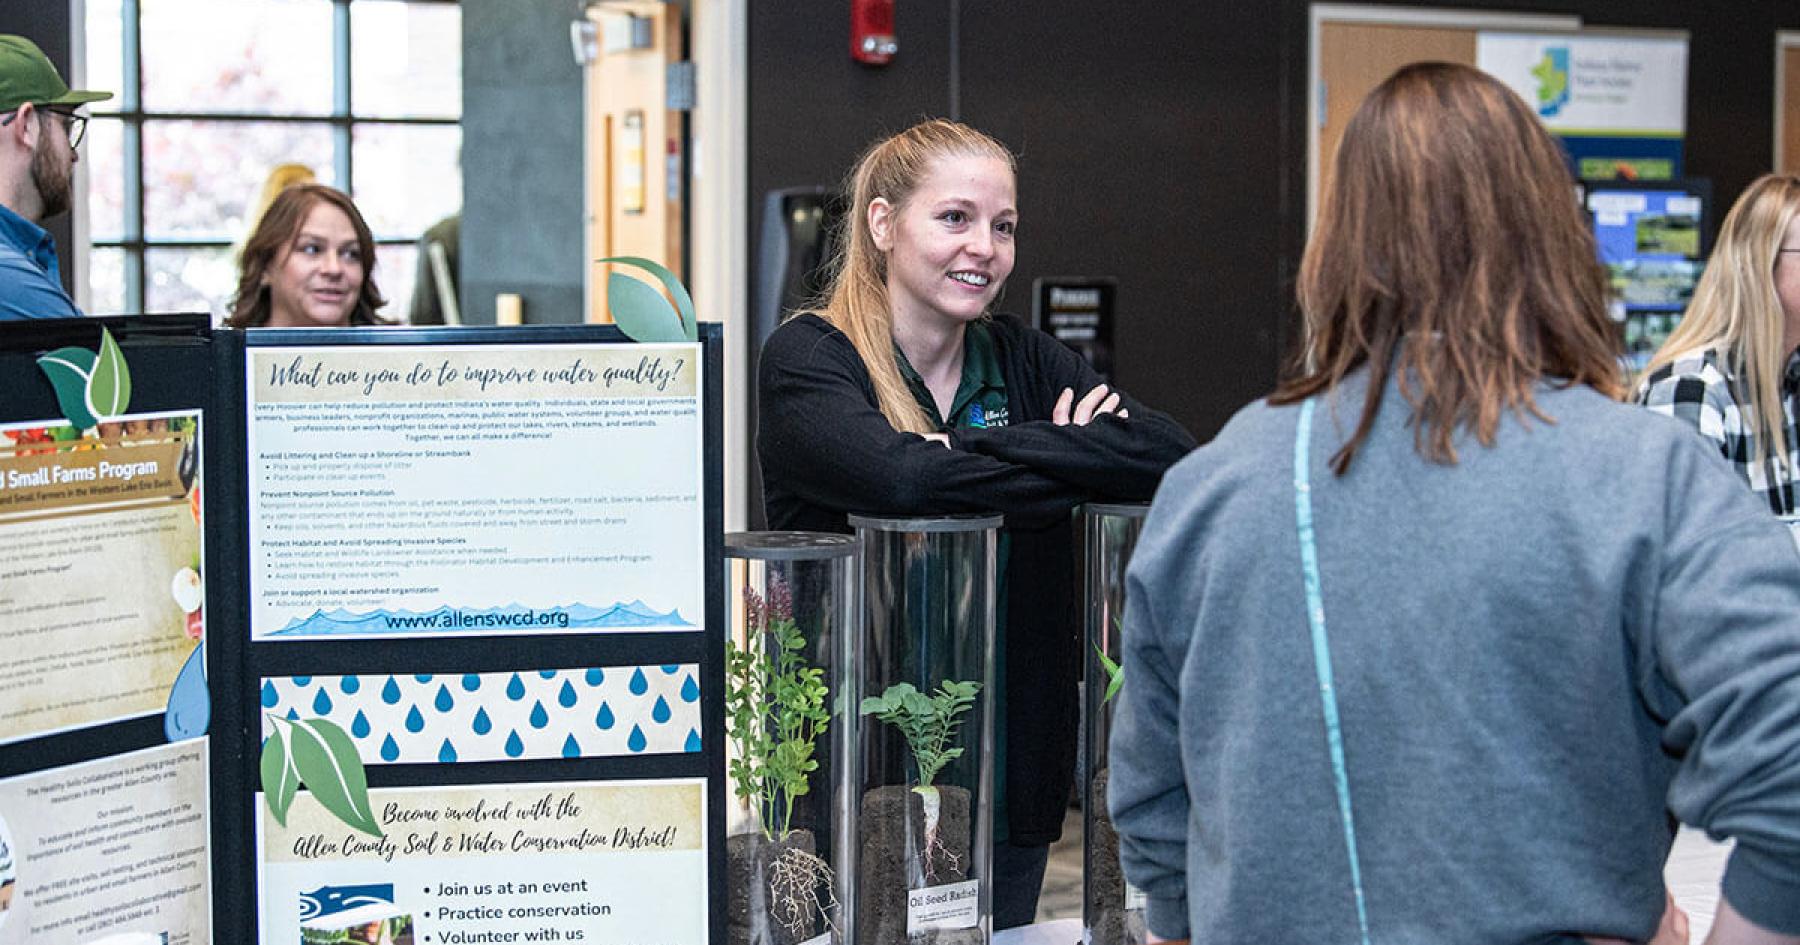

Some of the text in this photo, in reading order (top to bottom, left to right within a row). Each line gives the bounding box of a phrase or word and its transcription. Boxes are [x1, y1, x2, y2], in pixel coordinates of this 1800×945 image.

[268, 355, 684, 395] What can you do to improve water quality?
[323, 402, 339, 411] help
[371, 402, 406, 410] pollution
[423, 401, 453, 409] protect
[293, 424, 345, 433] professionals
[382, 423, 416, 431] together
[478, 422, 506, 430] protect
[284, 452, 316, 460] Littering
[8, 467, 50, 489] Small
[52, 464, 97, 484] Farms
[99, 461, 158, 481] Program
[292, 490, 329, 498] Nonpoint
[362, 538, 401, 546] Spreading
[436, 537, 466, 545] Species
[290, 588, 321, 597] support
[391, 586, 439, 595] organization
[386, 608, 569, 631] www.allenswcd.org
[383, 792, 582, 825] Become involved with the
[294, 825, 677, 863] Allen County Soil & Water Conservation District!
[438, 879, 588, 896] Join us at an event
[911, 897, 923, 907] Oil
[925, 892, 947, 905] Seed
[438, 903, 611, 920] Practice conservation
[438, 928, 585, 944] Volunteer with us
